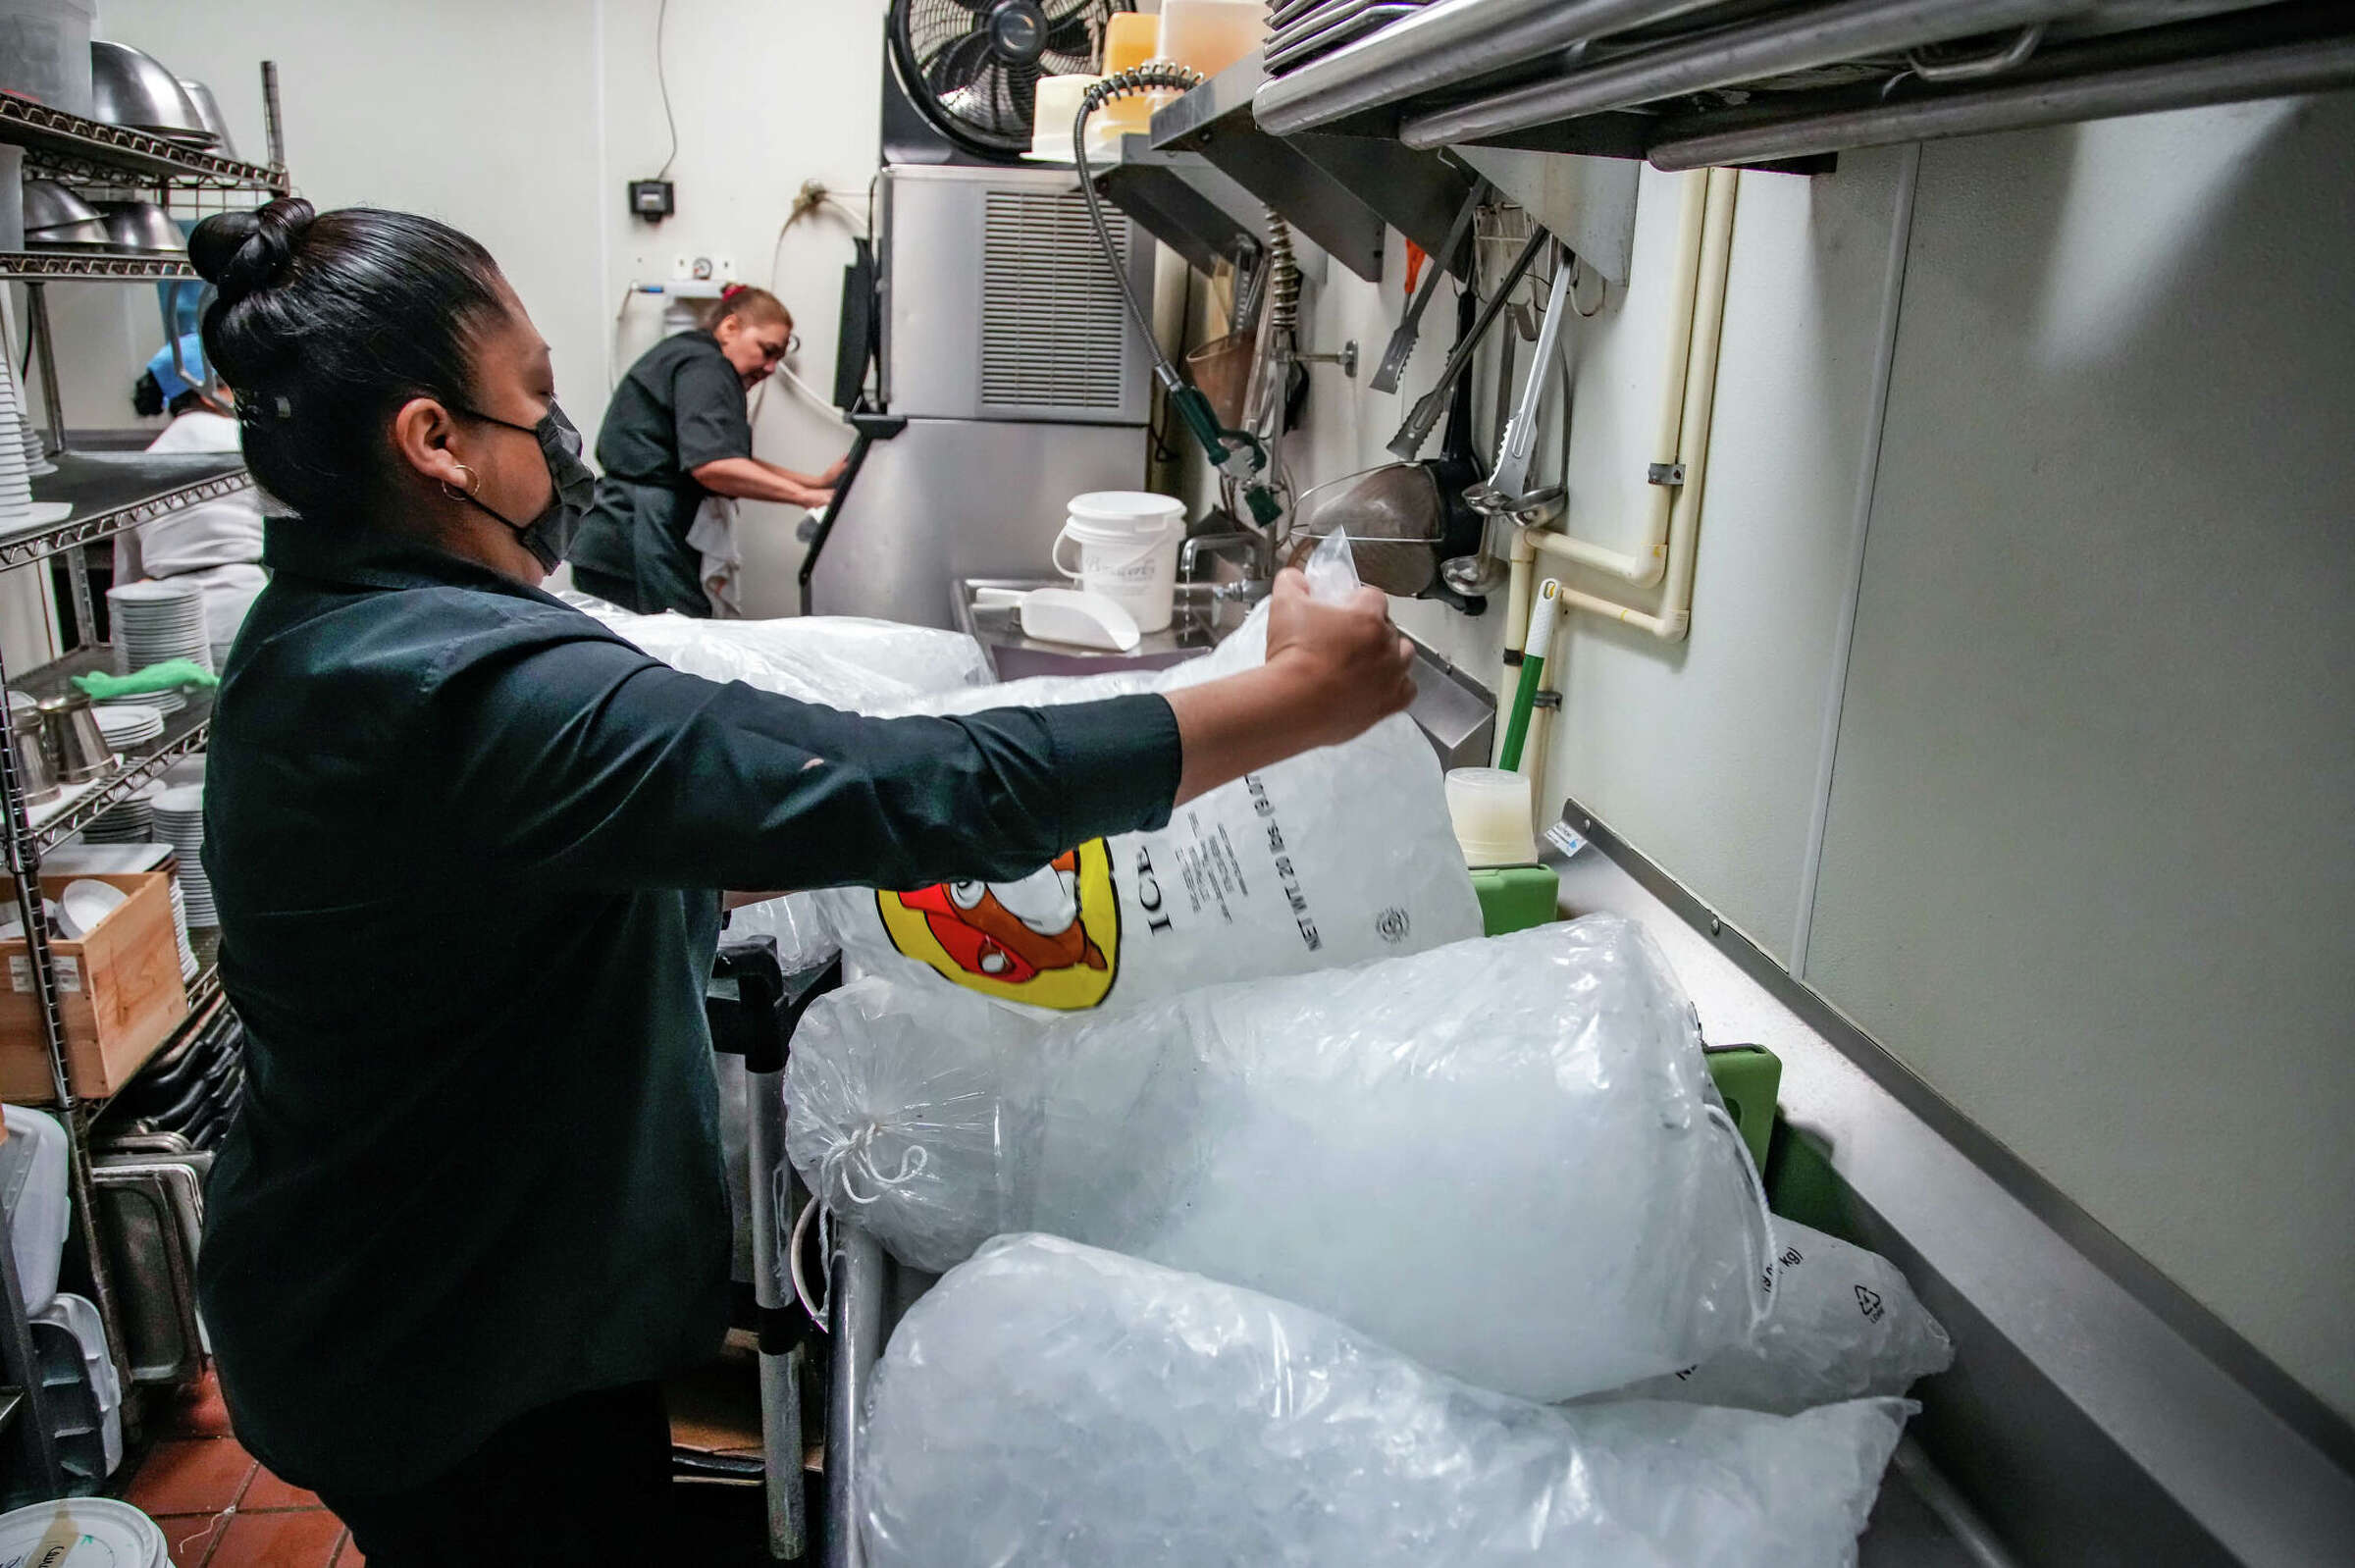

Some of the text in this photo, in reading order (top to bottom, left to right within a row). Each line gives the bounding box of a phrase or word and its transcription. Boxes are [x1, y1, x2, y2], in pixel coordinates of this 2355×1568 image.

[1275, 856, 1295, 880] 20
[1136, 845, 1174, 936] ICE
[1296, 917, 1323, 952] NET
[1778, 1245, 1805, 1268] kg)
